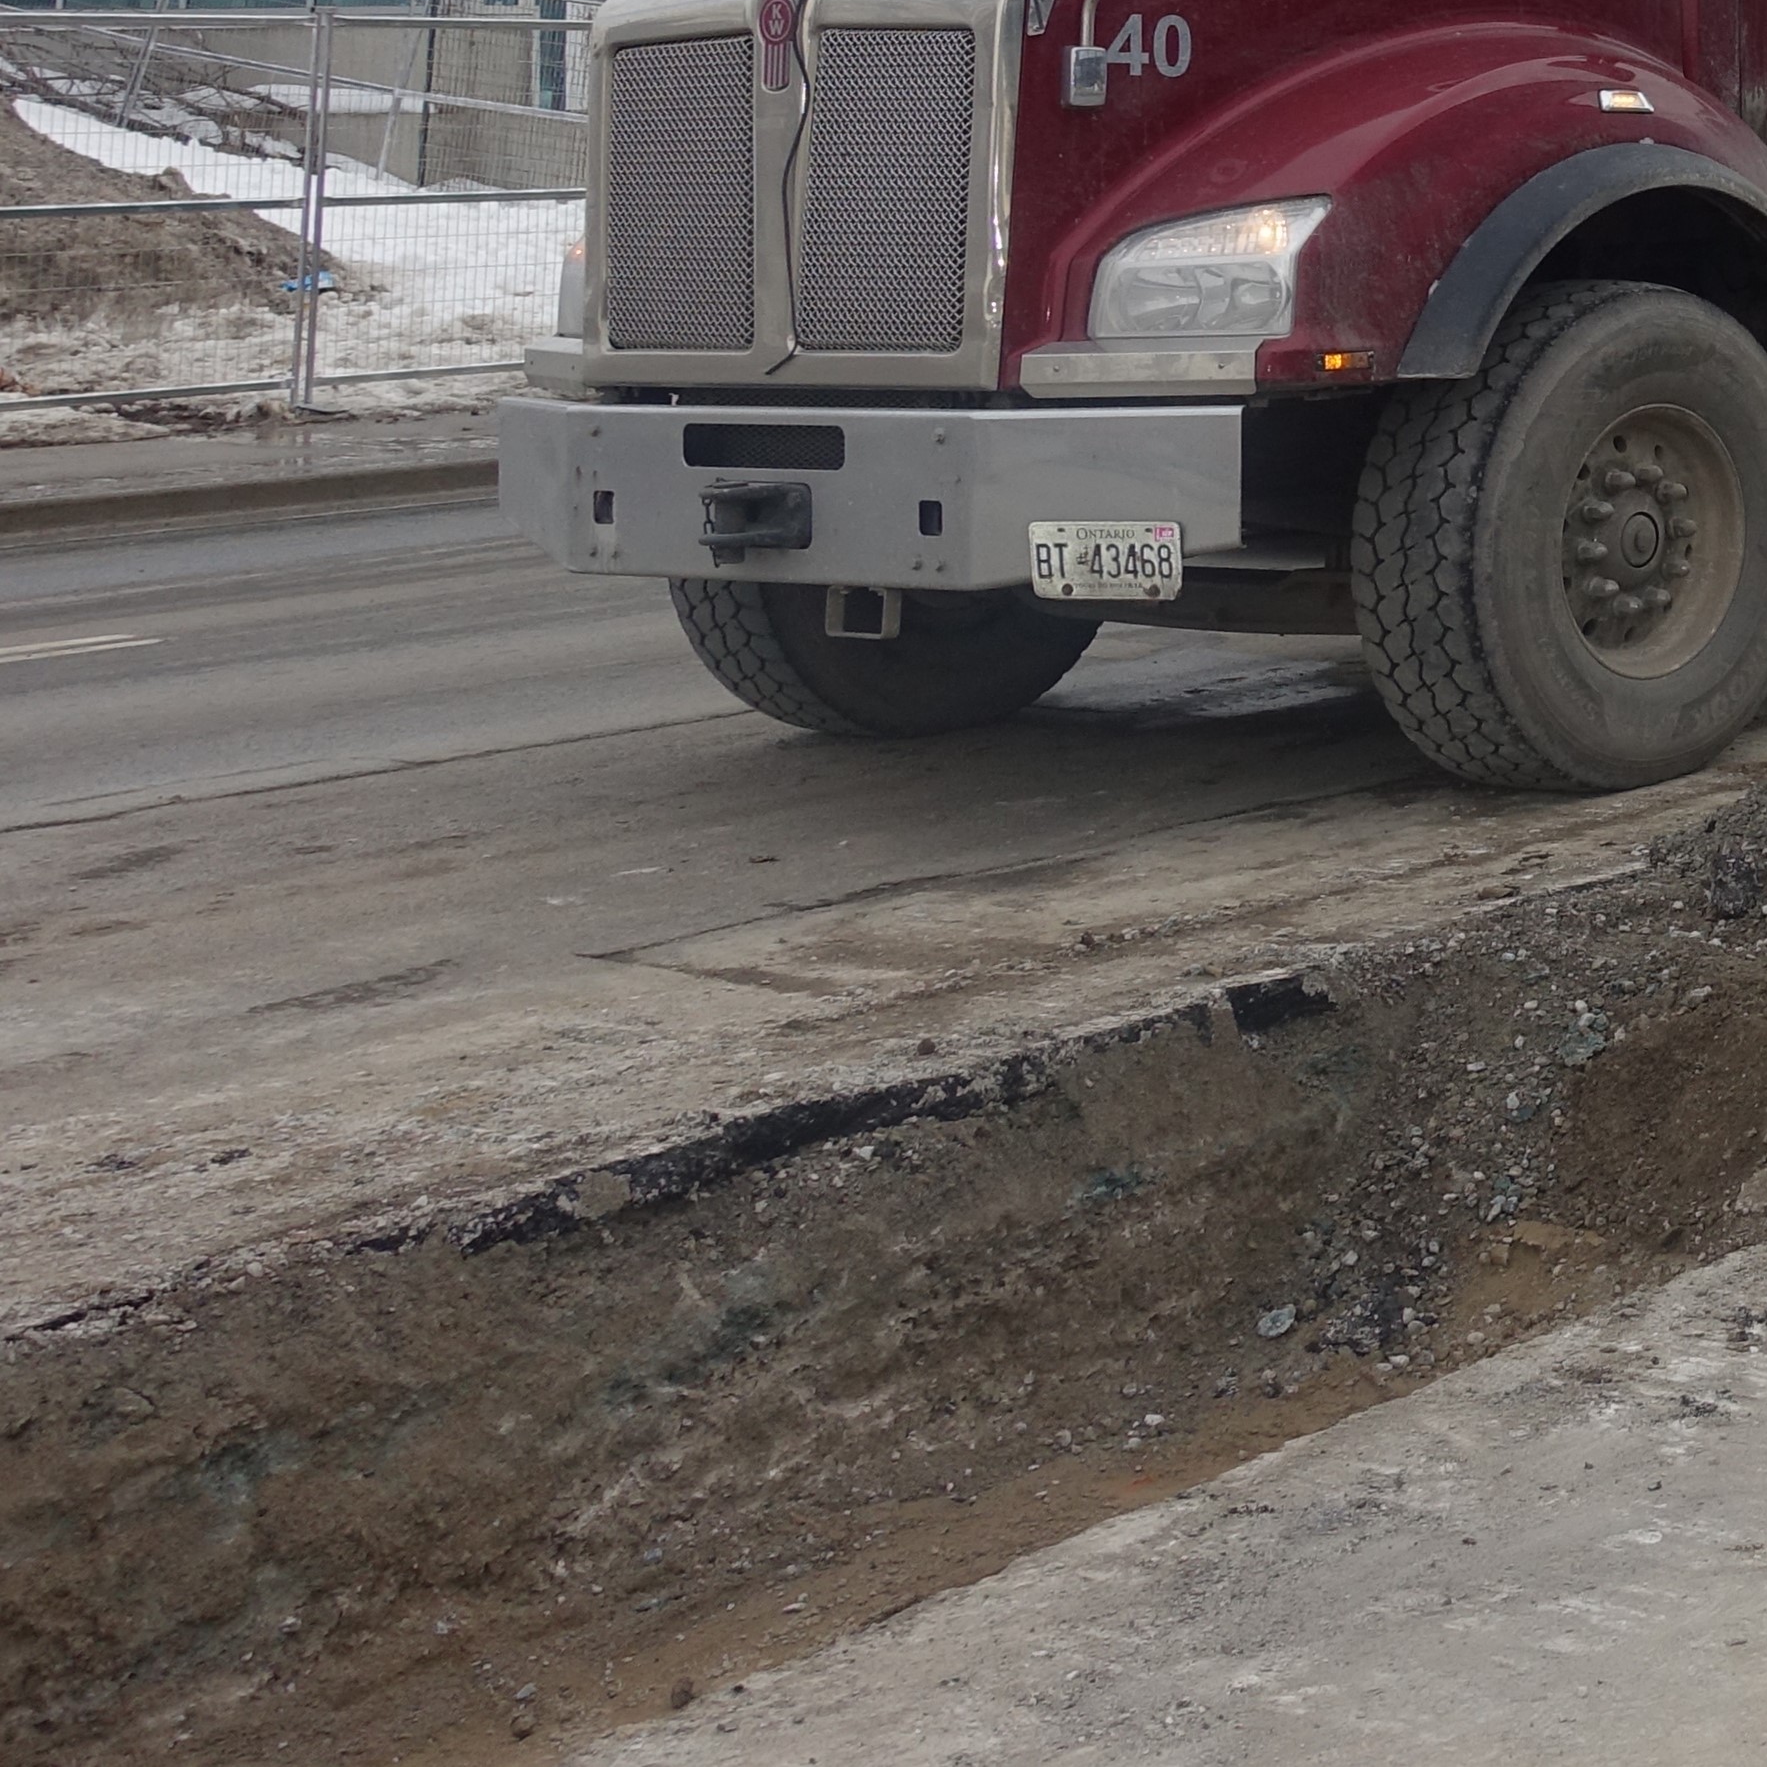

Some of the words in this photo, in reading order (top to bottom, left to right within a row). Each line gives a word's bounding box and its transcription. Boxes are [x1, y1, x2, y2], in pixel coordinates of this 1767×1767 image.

[1106, 13, 1192, 78] 40
[1076, 527, 1136, 541] ONTARIO
[1036, 543, 1069, 579] BT
[1090, 543, 1174, 580] 43468
